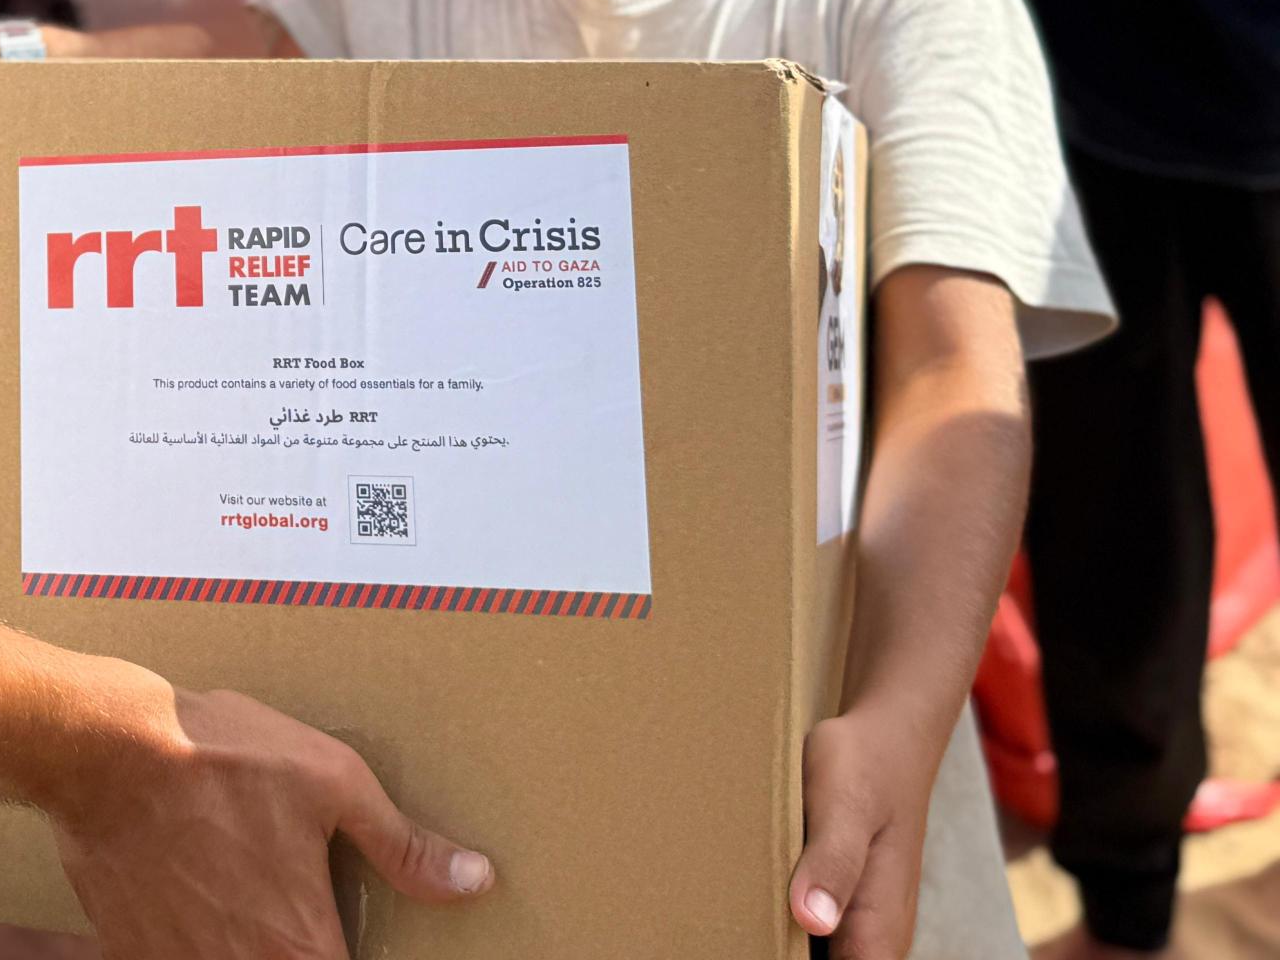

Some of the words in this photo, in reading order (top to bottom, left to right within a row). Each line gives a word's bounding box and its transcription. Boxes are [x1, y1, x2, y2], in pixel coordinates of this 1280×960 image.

[228, 226, 311, 250] RAPID
[339, 222, 426, 256] Care
[434, 220, 473, 253] in
[479, 217, 601, 253] Crisis
[47, 206, 218, 309] rrt
[229, 255, 311, 278] RELIEF
[501, 260, 527, 272] AID
[531, 260, 553, 272] TO
[558, 259, 601, 272] GAZA
[502, 276, 574, 291] Operation
[576, 276, 602, 288] 825
[227, 283, 311, 307] TEAM
[272, 357, 301, 369] RRT
[304, 357, 336, 369] Food
[339, 357, 365, 369] Box
[153, 378, 175, 389] This
[177, 378, 218, 391] product
[221, 378, 266, 389] contains
[269, 381, 276, 389] a
[279, 378, 315, 391] variety
[317, 378, 329, 389] of
[332, 378, 357, 389] food
[360, 378, 415, 389] essentials
[419, 378, 433, 389] for
[437, 381, 444, 389] a
[448, 378, 484, 392] family.
[269, 407, 311, 430] غذائي
[316, 409, 344, 426] طرد
[349, 412, 378, 423] RRT
[129, 431, 159, 444] للعائلة
[162, 431, 207, 446] الأساسية
[210, 432, 248, 447] الغذائية
[251, 434, 280, 447] المواد
[283, 436, 300, 448] من
[303, 433, 339, 448] متنوعة
[342, 434, 384, 449] مجموعة
[387, 435, 408, 449] على
[411, 435, 446, 451] المنتج
[448, 435, 468, 448] هذا
[220, 493, 243, 505] Visit
[246, 496, 265, 505] our
[268, 495, 313, 507] website
[315, 496, 327, 507] at
[221, 513, 328, 531] rrtglobal.org
